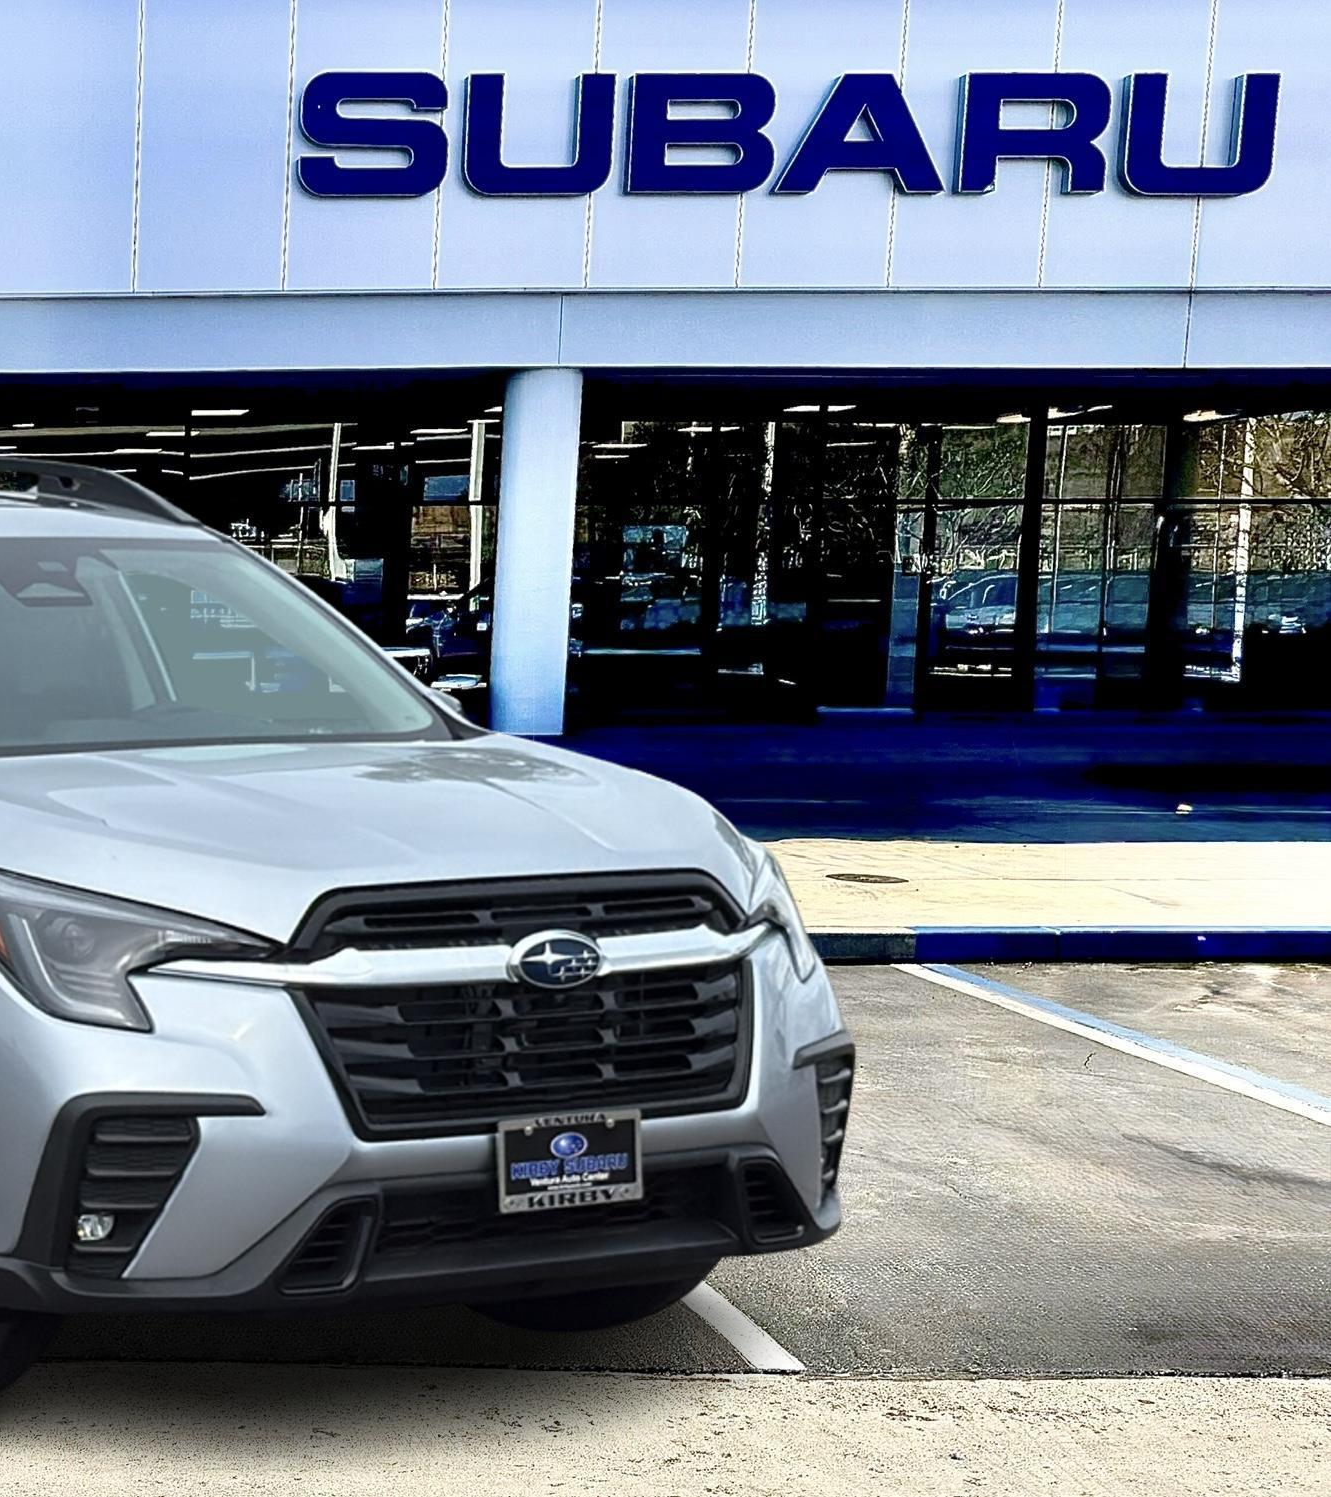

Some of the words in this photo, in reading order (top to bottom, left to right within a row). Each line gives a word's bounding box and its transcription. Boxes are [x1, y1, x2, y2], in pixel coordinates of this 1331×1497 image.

[296, 70, 1282, 198] SUBARU
[535, 1113, 606, 1126] VENTURA
[511, 1160, 559, 1180] KIRBY
[563, 1153, 628, 1173] SUBARU
[530, 1177, 560, 1187] Ventura
[561, 1174, 581, 1183] Auto
[581, 1171, 610, 1182] Center
[529, 1189, 616, 1208] KIRBY
